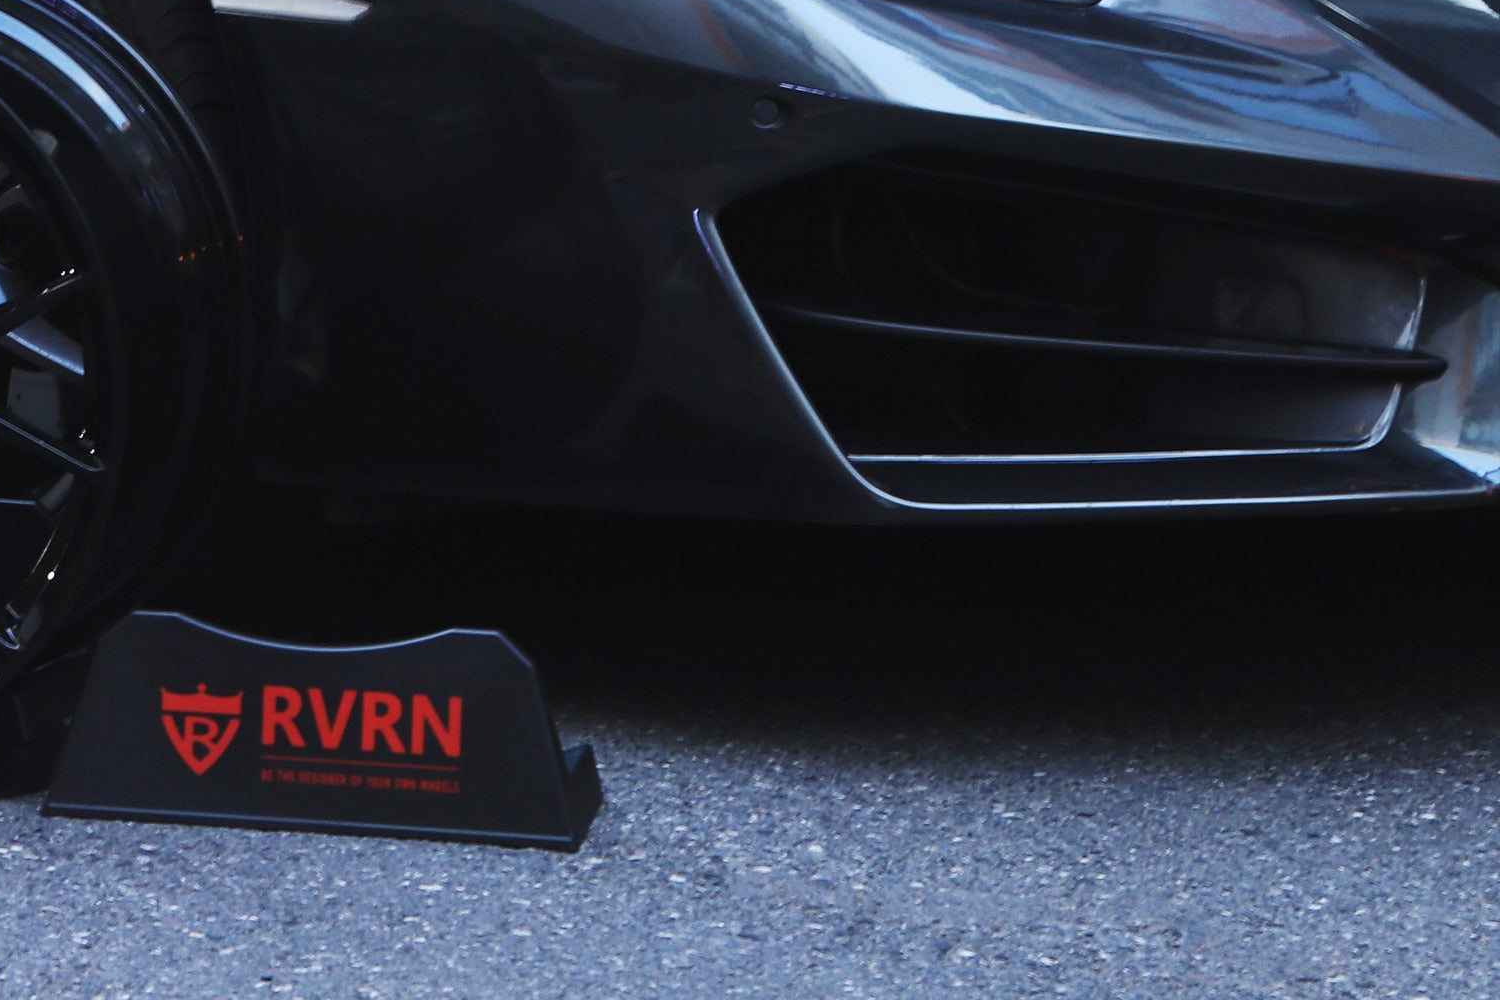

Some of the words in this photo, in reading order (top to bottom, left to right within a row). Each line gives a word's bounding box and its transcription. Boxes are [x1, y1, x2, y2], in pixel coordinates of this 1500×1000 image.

[260, 685, 463, 757] RVRN
[260, 767, 273, 782] BE
[276, 768, 295, 784] THE
[299, 770, 347, 787] DESIGNER
[350, 773, 363, 788] OF
[365, 774, 391, 790] YOUR
